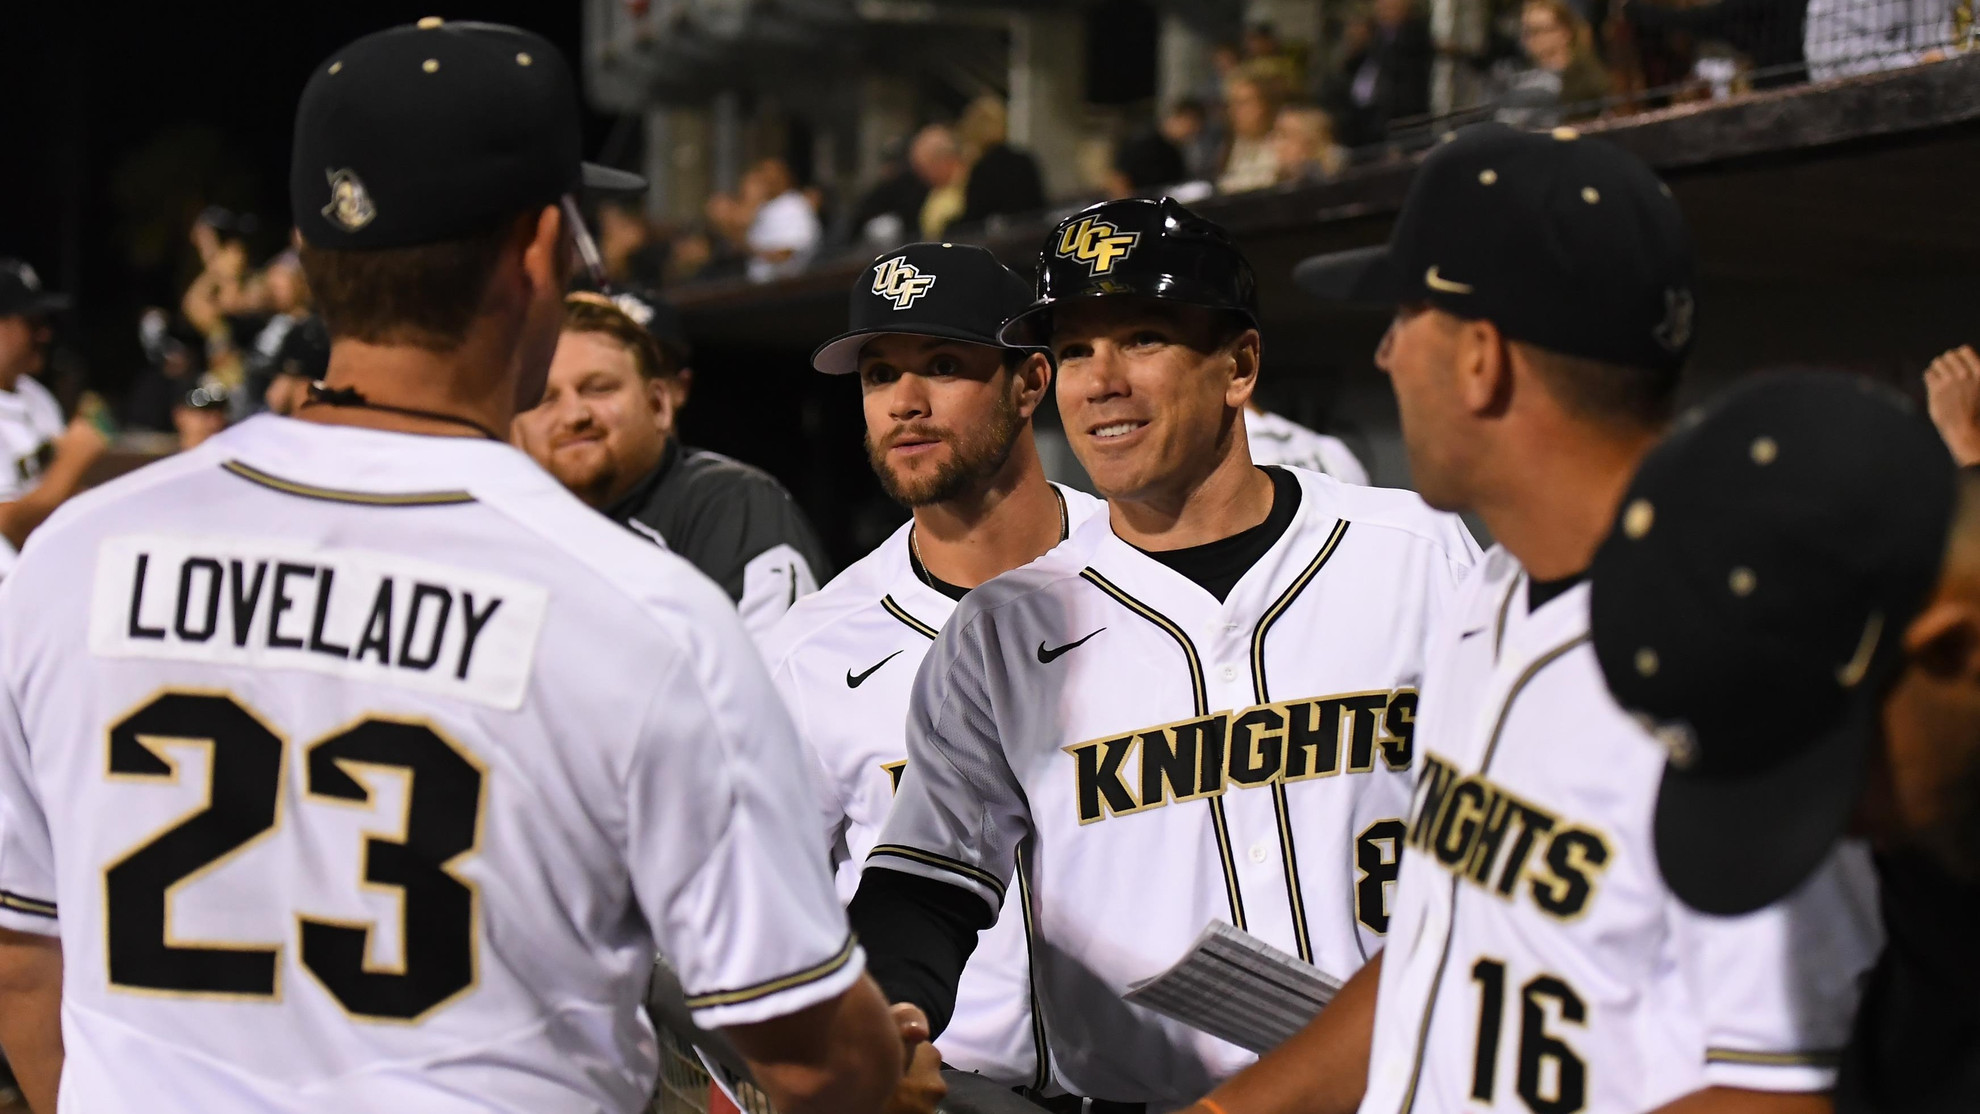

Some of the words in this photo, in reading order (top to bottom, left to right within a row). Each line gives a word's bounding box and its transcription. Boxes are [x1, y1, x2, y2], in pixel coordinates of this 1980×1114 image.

[871, 256, 936, 310] UCF
[1056, 215, 1141, 277] UCF
[128, 553, 502, 679] LOVELADY
[1061, 688, 1420, 826] KNIGHTS
[103, 685, 489, 1024] 23
[1469, 955, 1588, 1114] 16
